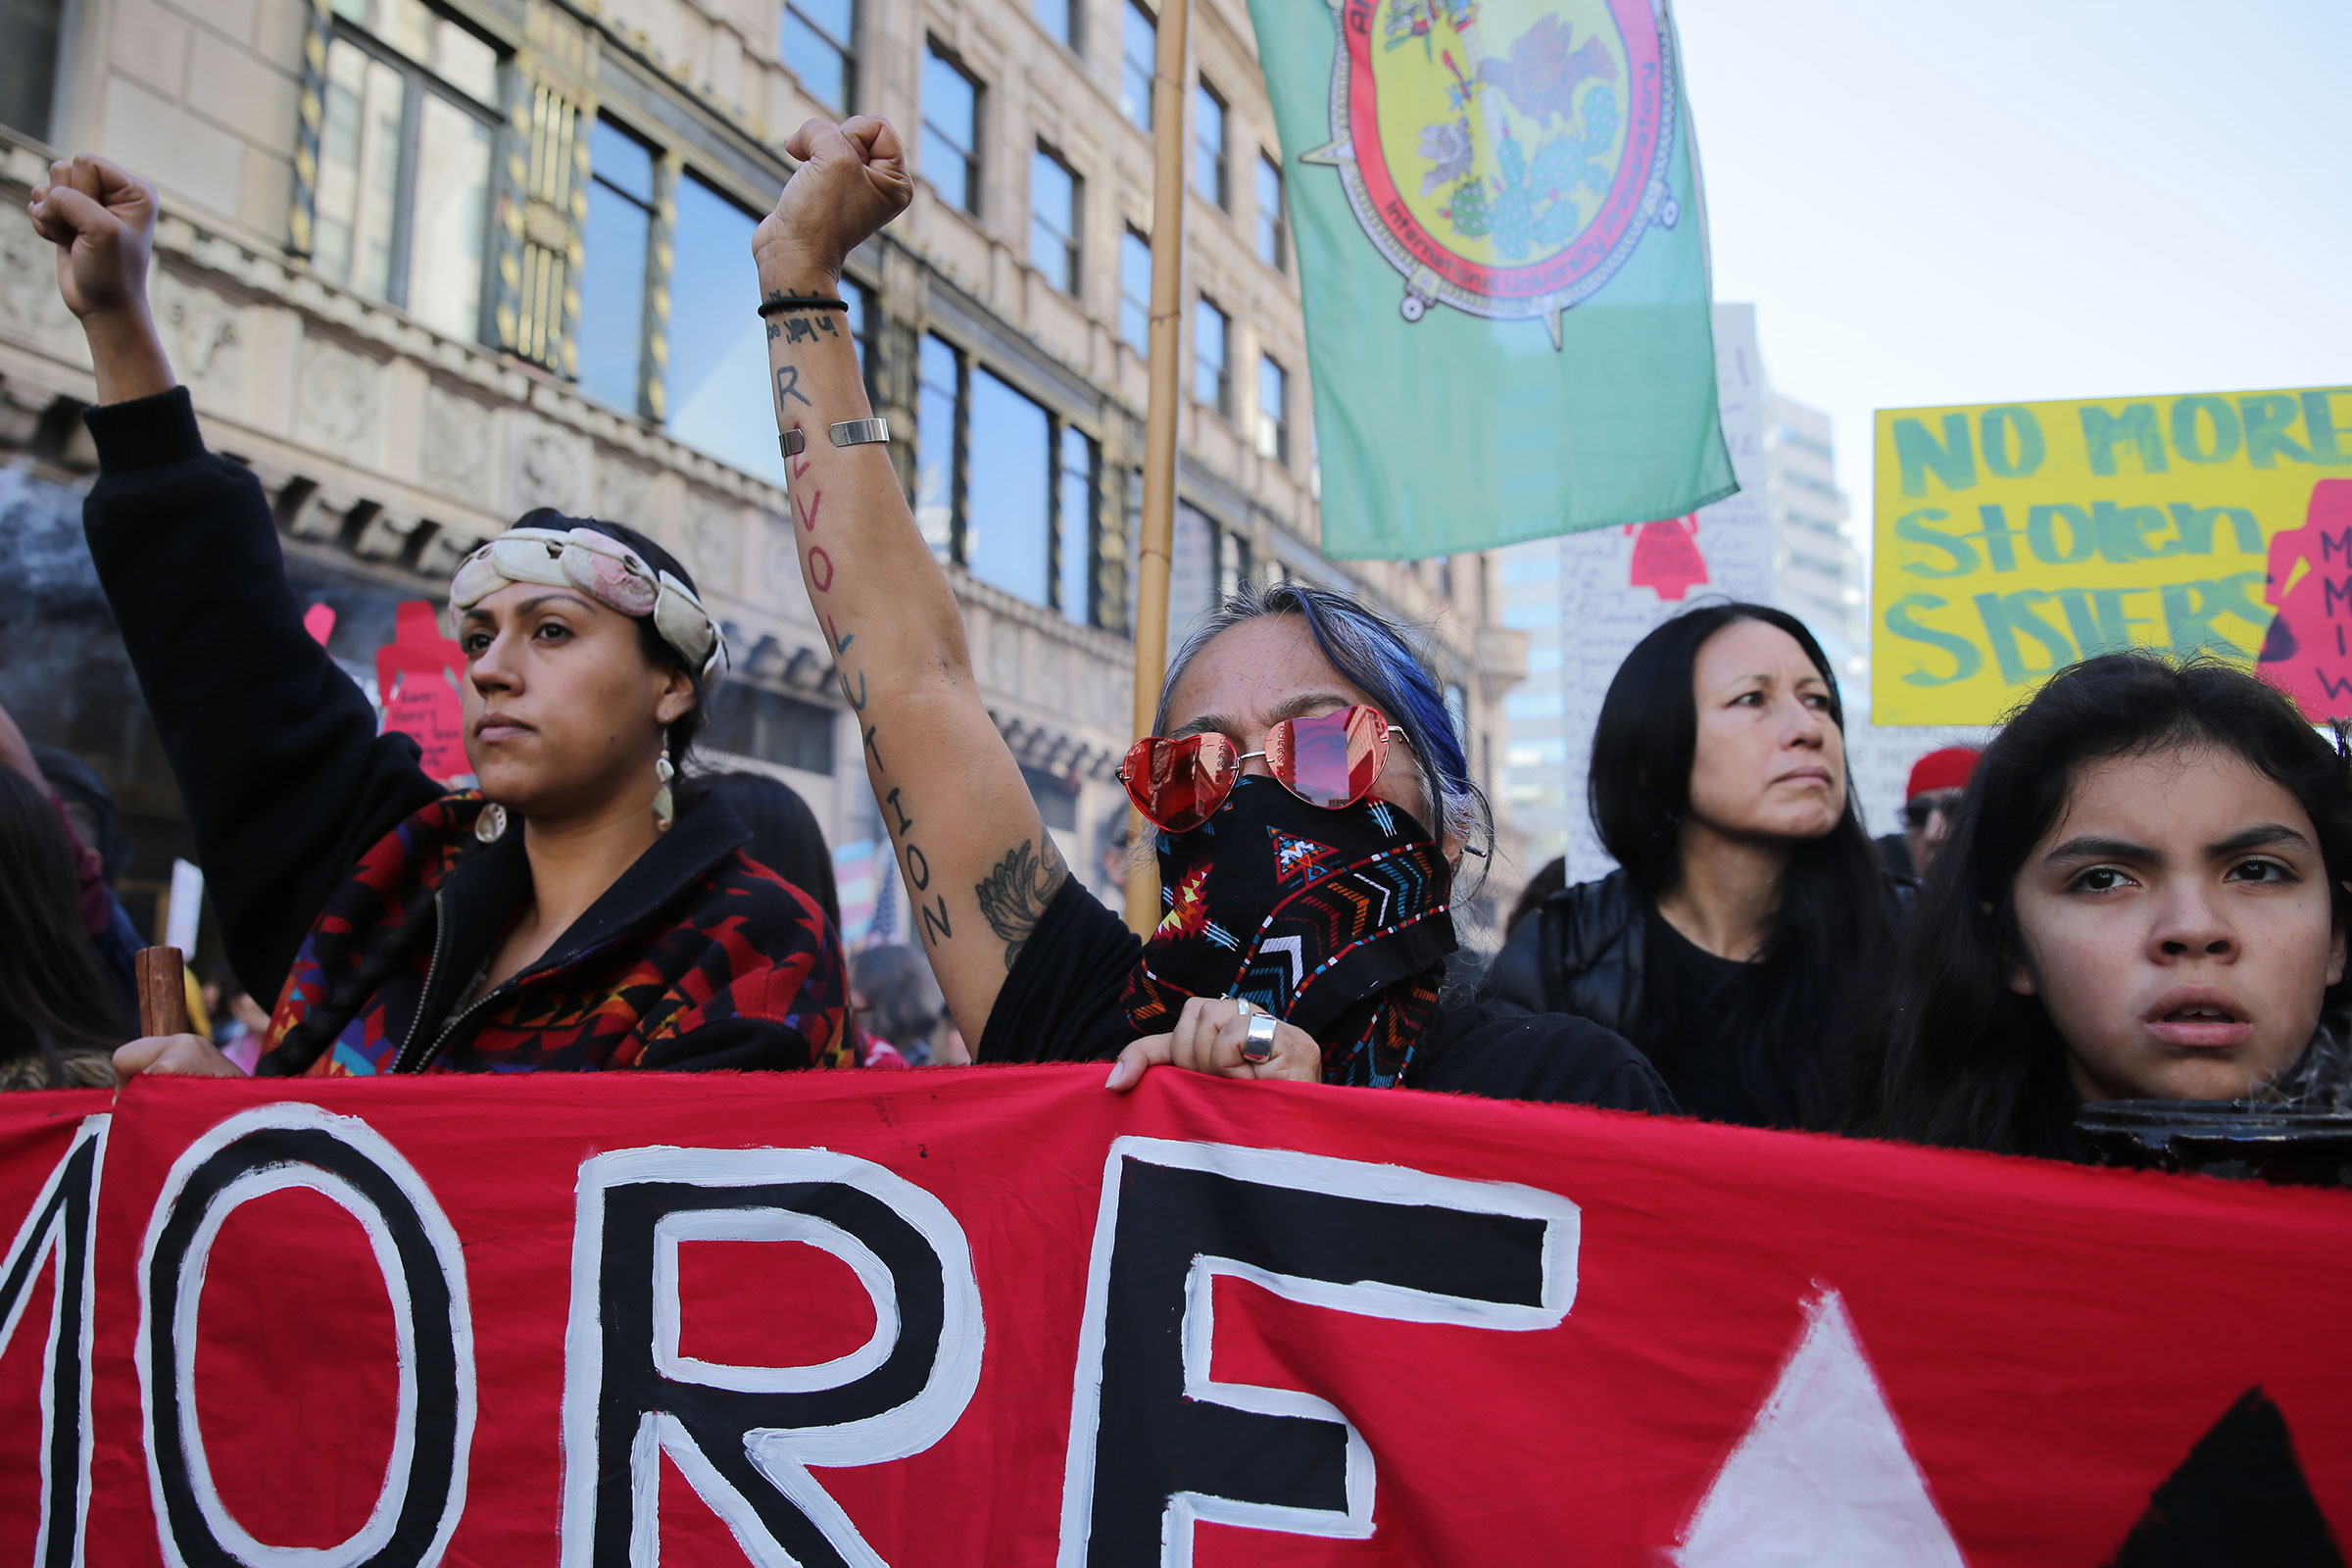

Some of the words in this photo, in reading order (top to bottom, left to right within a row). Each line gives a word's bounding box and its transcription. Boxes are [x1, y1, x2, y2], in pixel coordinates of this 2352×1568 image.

[1382, 199, 1498, 293] International
[1504, 240, 1605, 294] University
[1603, 62, 1657, 237] Preparatory
[1891, 405, 2047, 498] NO
[2078, 390, 2352, 477] MORE
